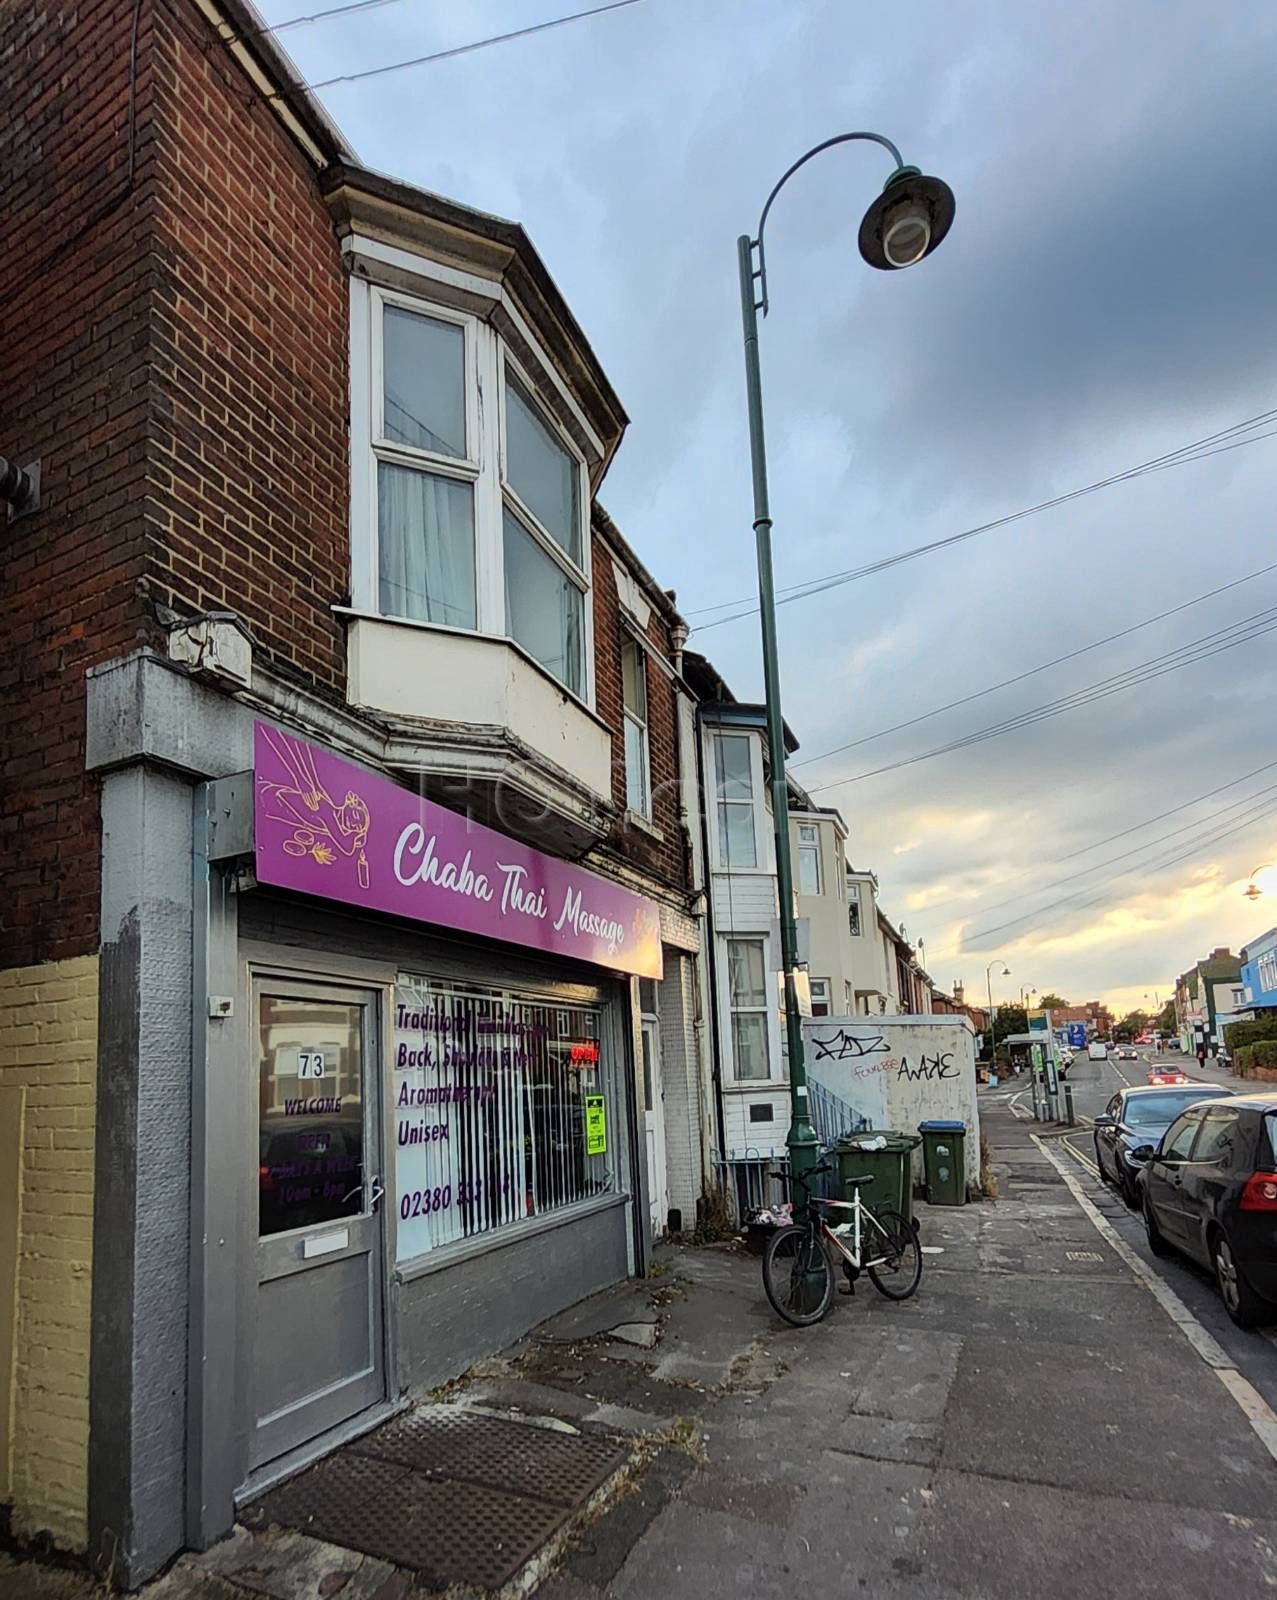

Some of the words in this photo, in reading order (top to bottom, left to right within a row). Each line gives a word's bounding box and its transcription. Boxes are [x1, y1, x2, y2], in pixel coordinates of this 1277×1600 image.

[393, 823, 494, 902] Chaba
[497, 861, 547, 920] Thai
[553, 885, 625, 955] Massage
[300, 1055, 323, 1077] 73
[398, 1043, 436, 1071] Back,
[897, 1052, 960, 1082] AWAKE
[284, 1096, 343, 1117] WELCOME
[399, 1120, 449, 1147] Unisex
[400, 1184, 452, 1220] 02380
